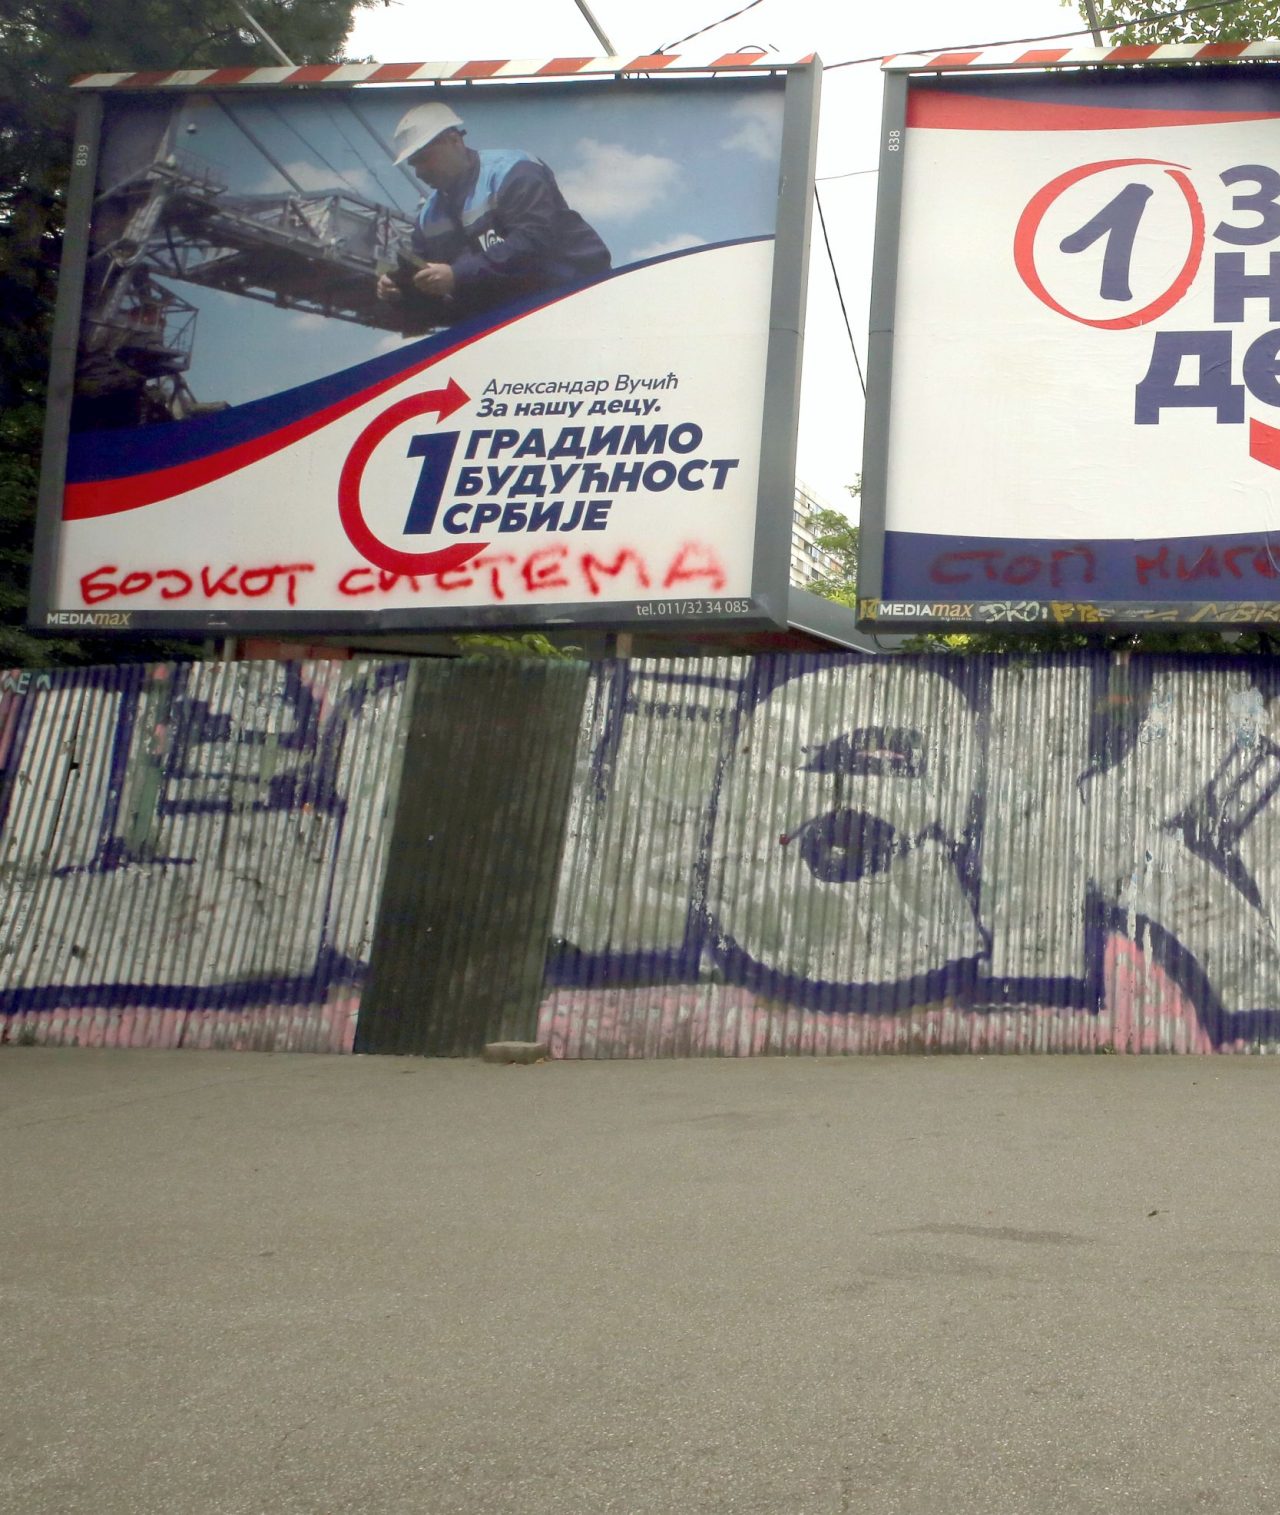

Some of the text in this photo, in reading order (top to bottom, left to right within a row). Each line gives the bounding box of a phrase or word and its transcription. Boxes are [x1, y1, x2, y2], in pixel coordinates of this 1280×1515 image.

[888, 130, 900, 152] 838
[1059, 183, 1154, 302] 1
[482, 372, 679, 396] Александар Вучић
[475, 397, 662, 418] За нашу децу.
[464, 422, 703, 460] ГРАДИМО
[402, 430, 461, 535] 1
[453, 458, 740, 499] БУДУЋНОСТ
[442, 499, 613, 534] СРБИЈЕ
[705, 601, 722, 615] 34
[725, 600, 749, 614] 085
